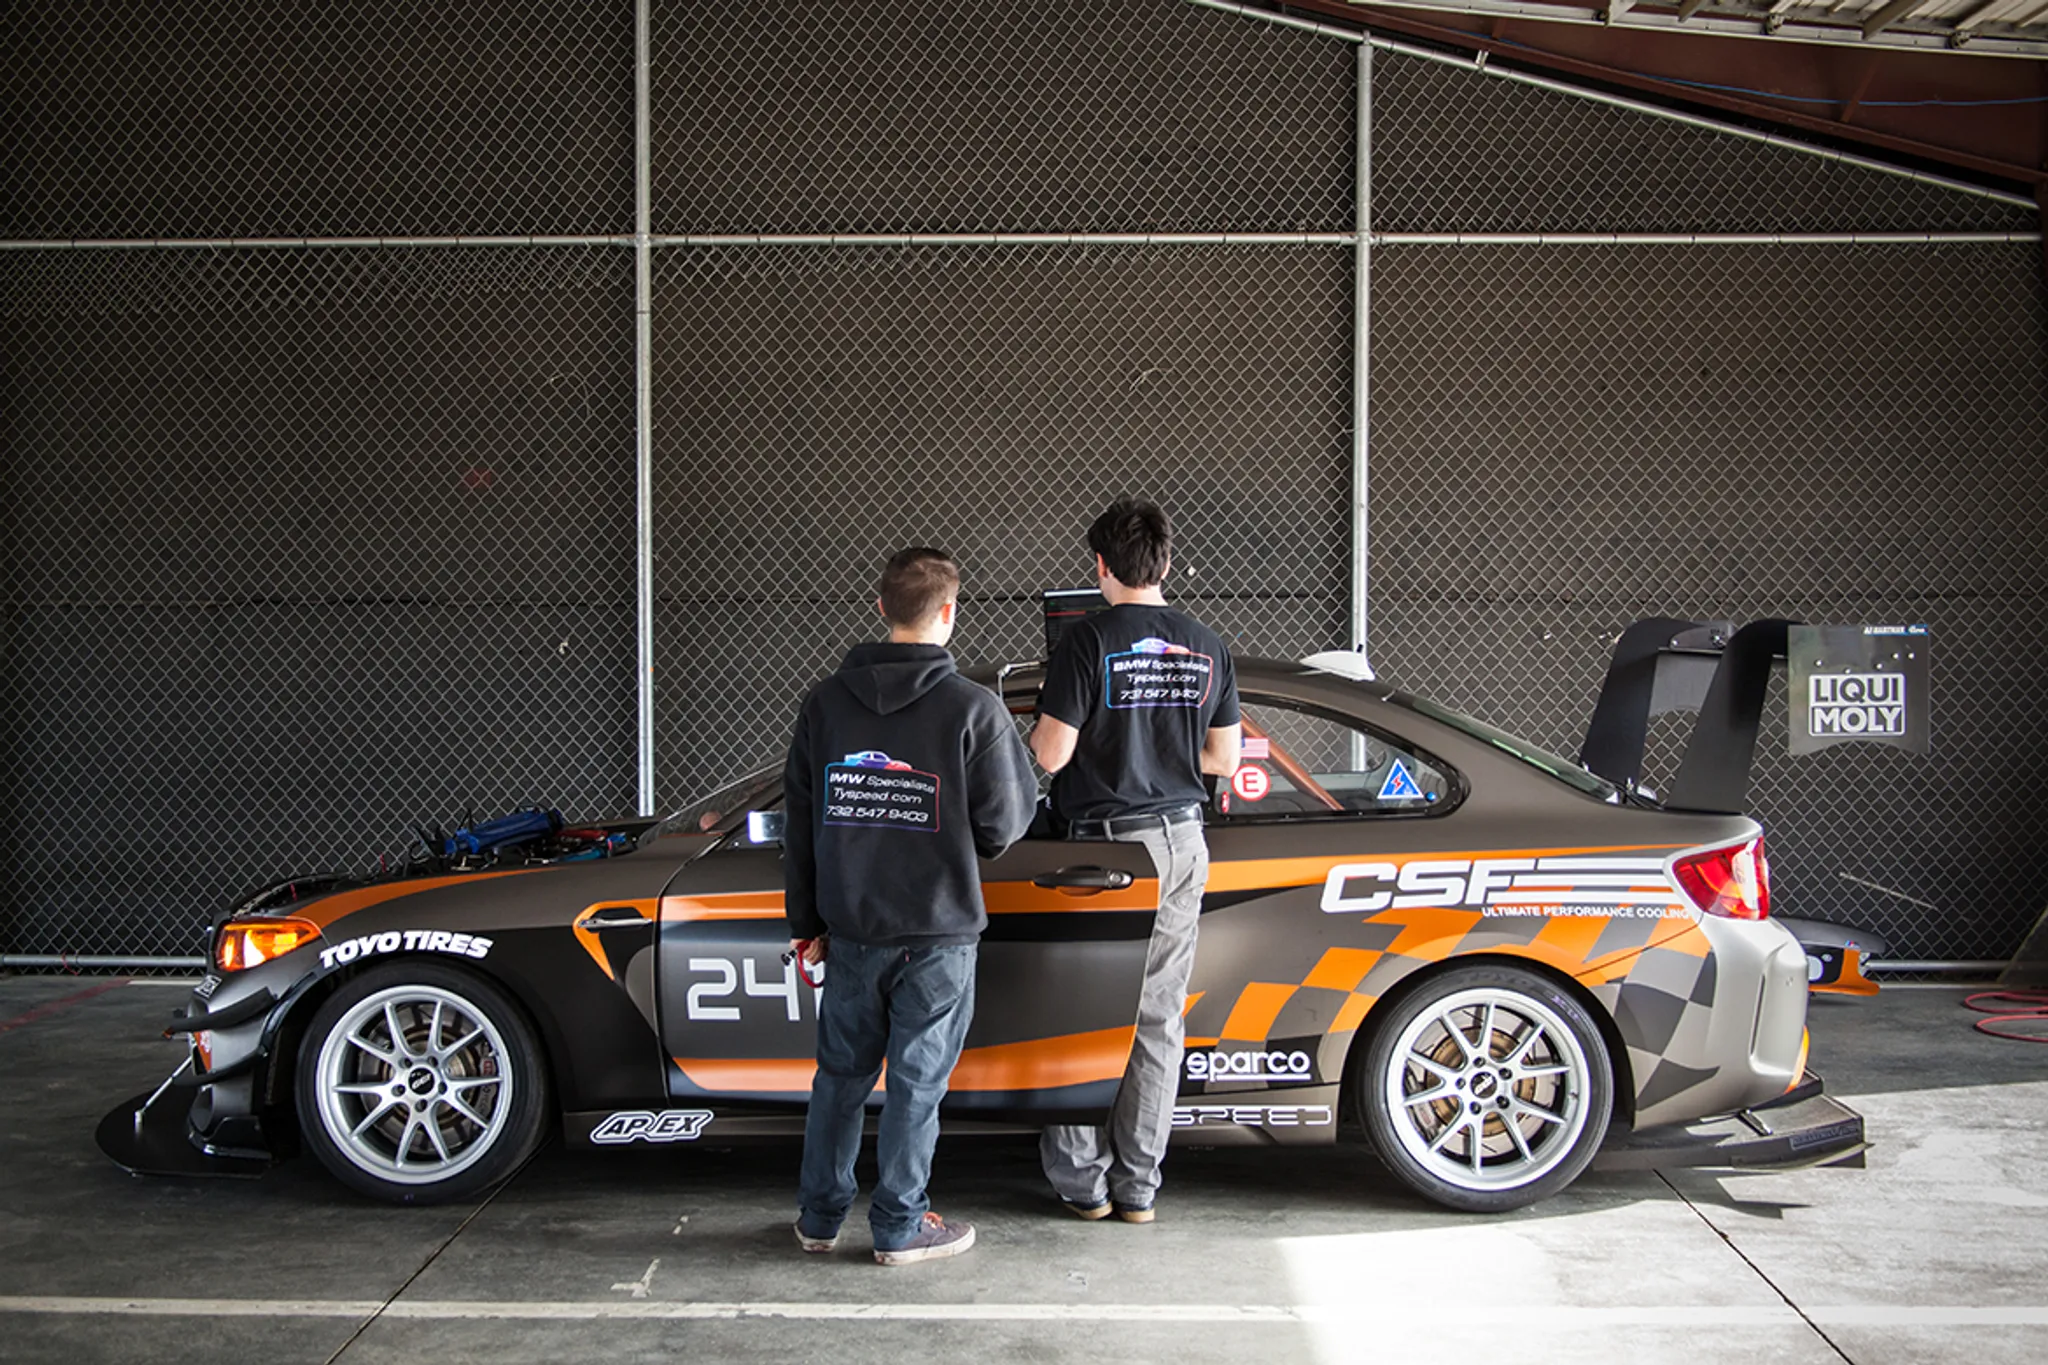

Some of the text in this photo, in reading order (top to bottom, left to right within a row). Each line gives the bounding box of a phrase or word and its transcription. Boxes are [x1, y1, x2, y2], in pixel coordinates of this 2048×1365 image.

[1113, 659, 1152, 672] BMW
[1814, 677, 1900, 704] LIQUI
[1813, 706, 1902, 733] MOLY
[1241, 771, 1260, 793] E
[826, 804, 929, 823] 732.547.9403
[1319, 858, 1537, 914] CSF
[1480, 905, 1691, 920] ULTIMATE PERFORMANCE COOLING
[319, 930, 494, 968] TOYO TIRES
[1186, 1051, 1311, 1082] sparco
[599, 1115, 705, 1137] APEX
[1171, 1104, 1332, 1126] SPEED
